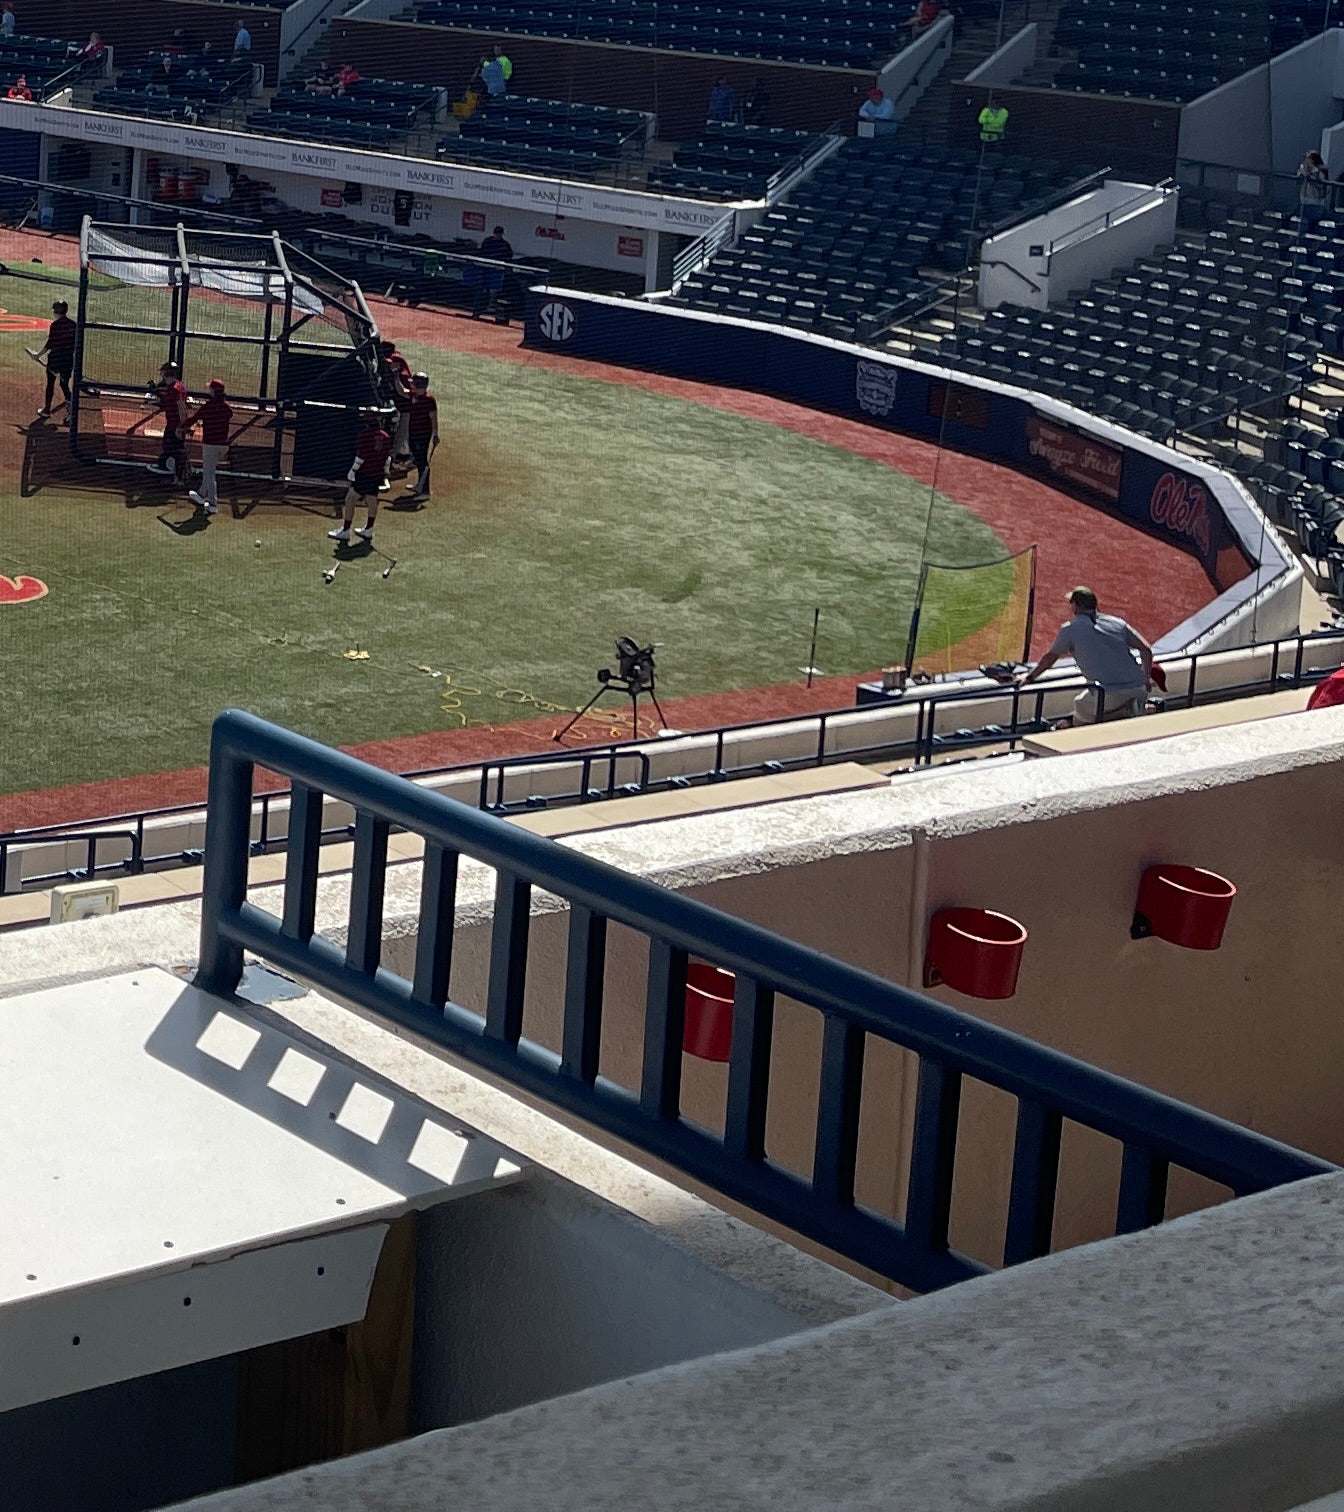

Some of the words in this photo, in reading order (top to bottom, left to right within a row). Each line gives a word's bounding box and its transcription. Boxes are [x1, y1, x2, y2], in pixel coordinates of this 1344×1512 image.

[84, 121, 123, 138] BANKFIRST
[292, 152, 336, 169] BANKFIRST
[407, 169, 454, 187] BANKFIRST
[530, 189, 583, 208] BANKFIRST
[540, 303, 575, 340] SEC
[1150, 472, 1190, 532] Ole
